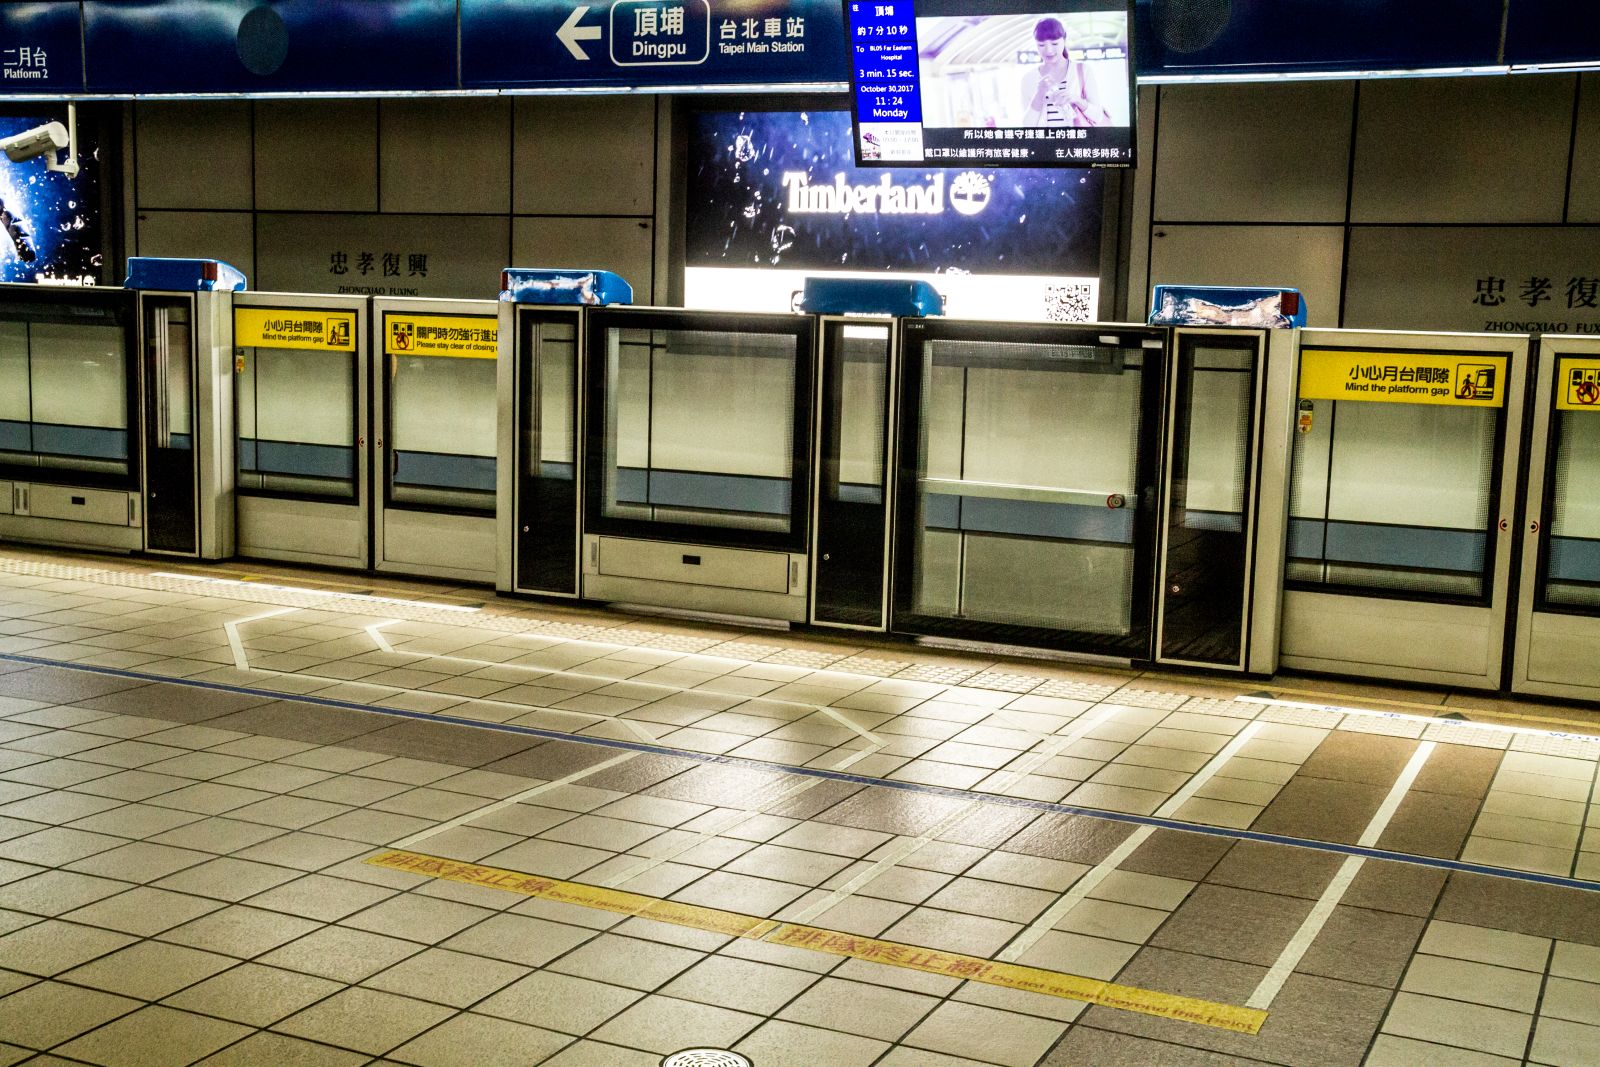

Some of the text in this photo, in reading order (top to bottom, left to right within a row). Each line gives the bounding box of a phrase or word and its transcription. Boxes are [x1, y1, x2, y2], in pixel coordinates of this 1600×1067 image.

[874, 5, 894, 17] 頂埔
[634, 6, 685, 36] 頂埔
[719, 17, 805, 39] 台北車站
[632, 41, 686, 58] Dingpu
[719, 41, 805, 55] Taipei Main Station
[856, 45, 865, 53] To
[3, 46, 47, 67] 二月台
[3, 68, 49, 78] Platform 2
[859, 68, 915, 78] 3 min. 15 sec.
[860, 84, 914, 93] October 30,2017
[872, 108, 908, 120] Monday
[782, 171, 944, 214] Timberland
[330, 251, 427, 277] 忠孝復興
[338, 286, 418, 297] ZHONGXIAO FUXING
[1473, 276, 1600, 308] 忠孝復
[263, 319, 323, 333] 小心月台間隙
[1484, 321, 1568, 333] ZHONGXIAO
[262, 332, 276, 340] Mind
[288, 333, 312, 342] platform
[313, 336, 324, 344] gap
[416, 340, 436, 349] Please
[437, 342, 449, 351] stay
[450, 342, 465, 350] clear
[472, 344, 495, 353] closing
[1348, 364, 1450, 383] 小心月台間隙
[1345, 382, 1450, 397] Mind the platform gap
[991, 974, 1014, 983] Do
